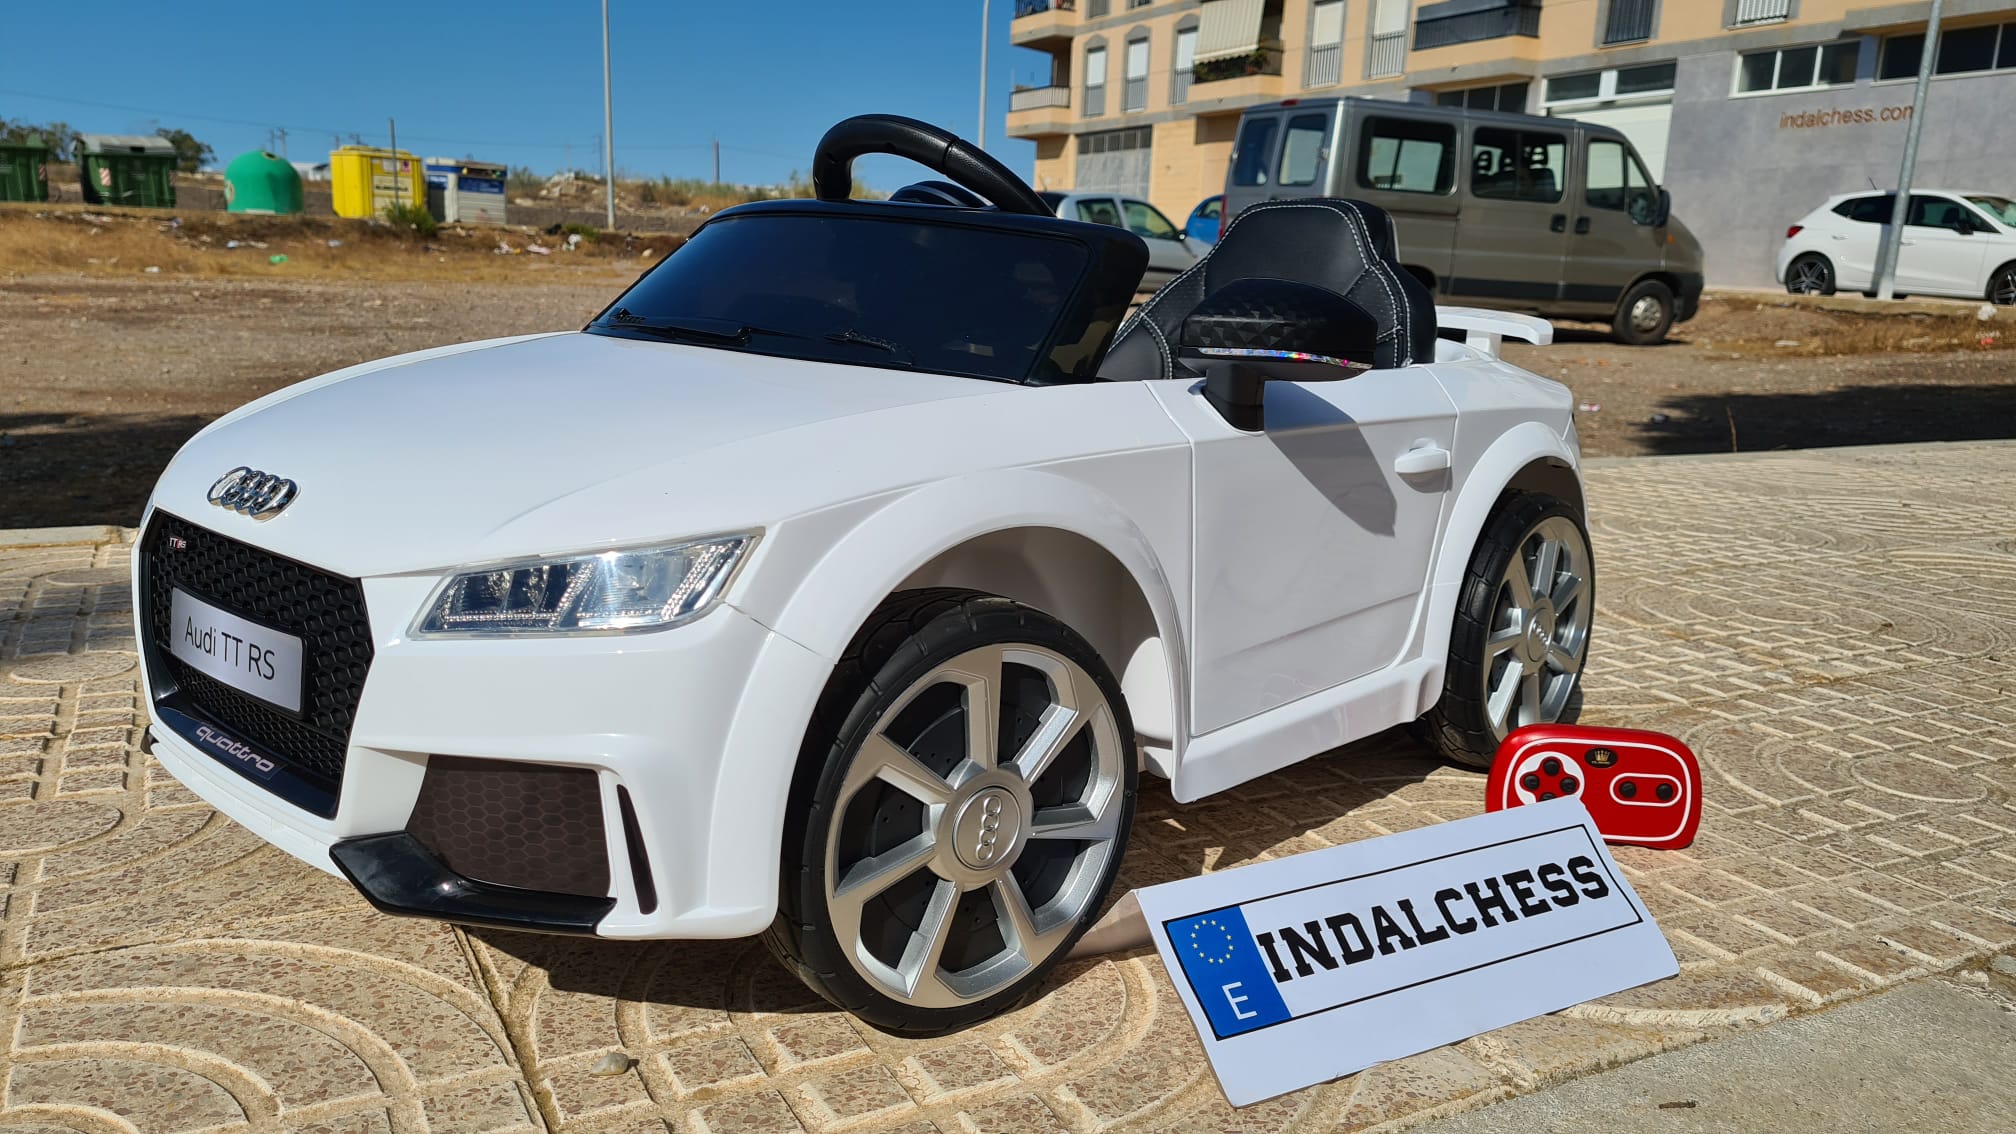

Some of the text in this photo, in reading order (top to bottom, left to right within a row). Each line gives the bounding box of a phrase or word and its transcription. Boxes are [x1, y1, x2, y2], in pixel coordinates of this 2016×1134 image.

[184, 615, 275, 681] Audi TT RS
[196, 725, 274, 773] quattro
[1256, 855, 1610, 983] INDALCHESS
[1221, 982, 1258, 1021] E
